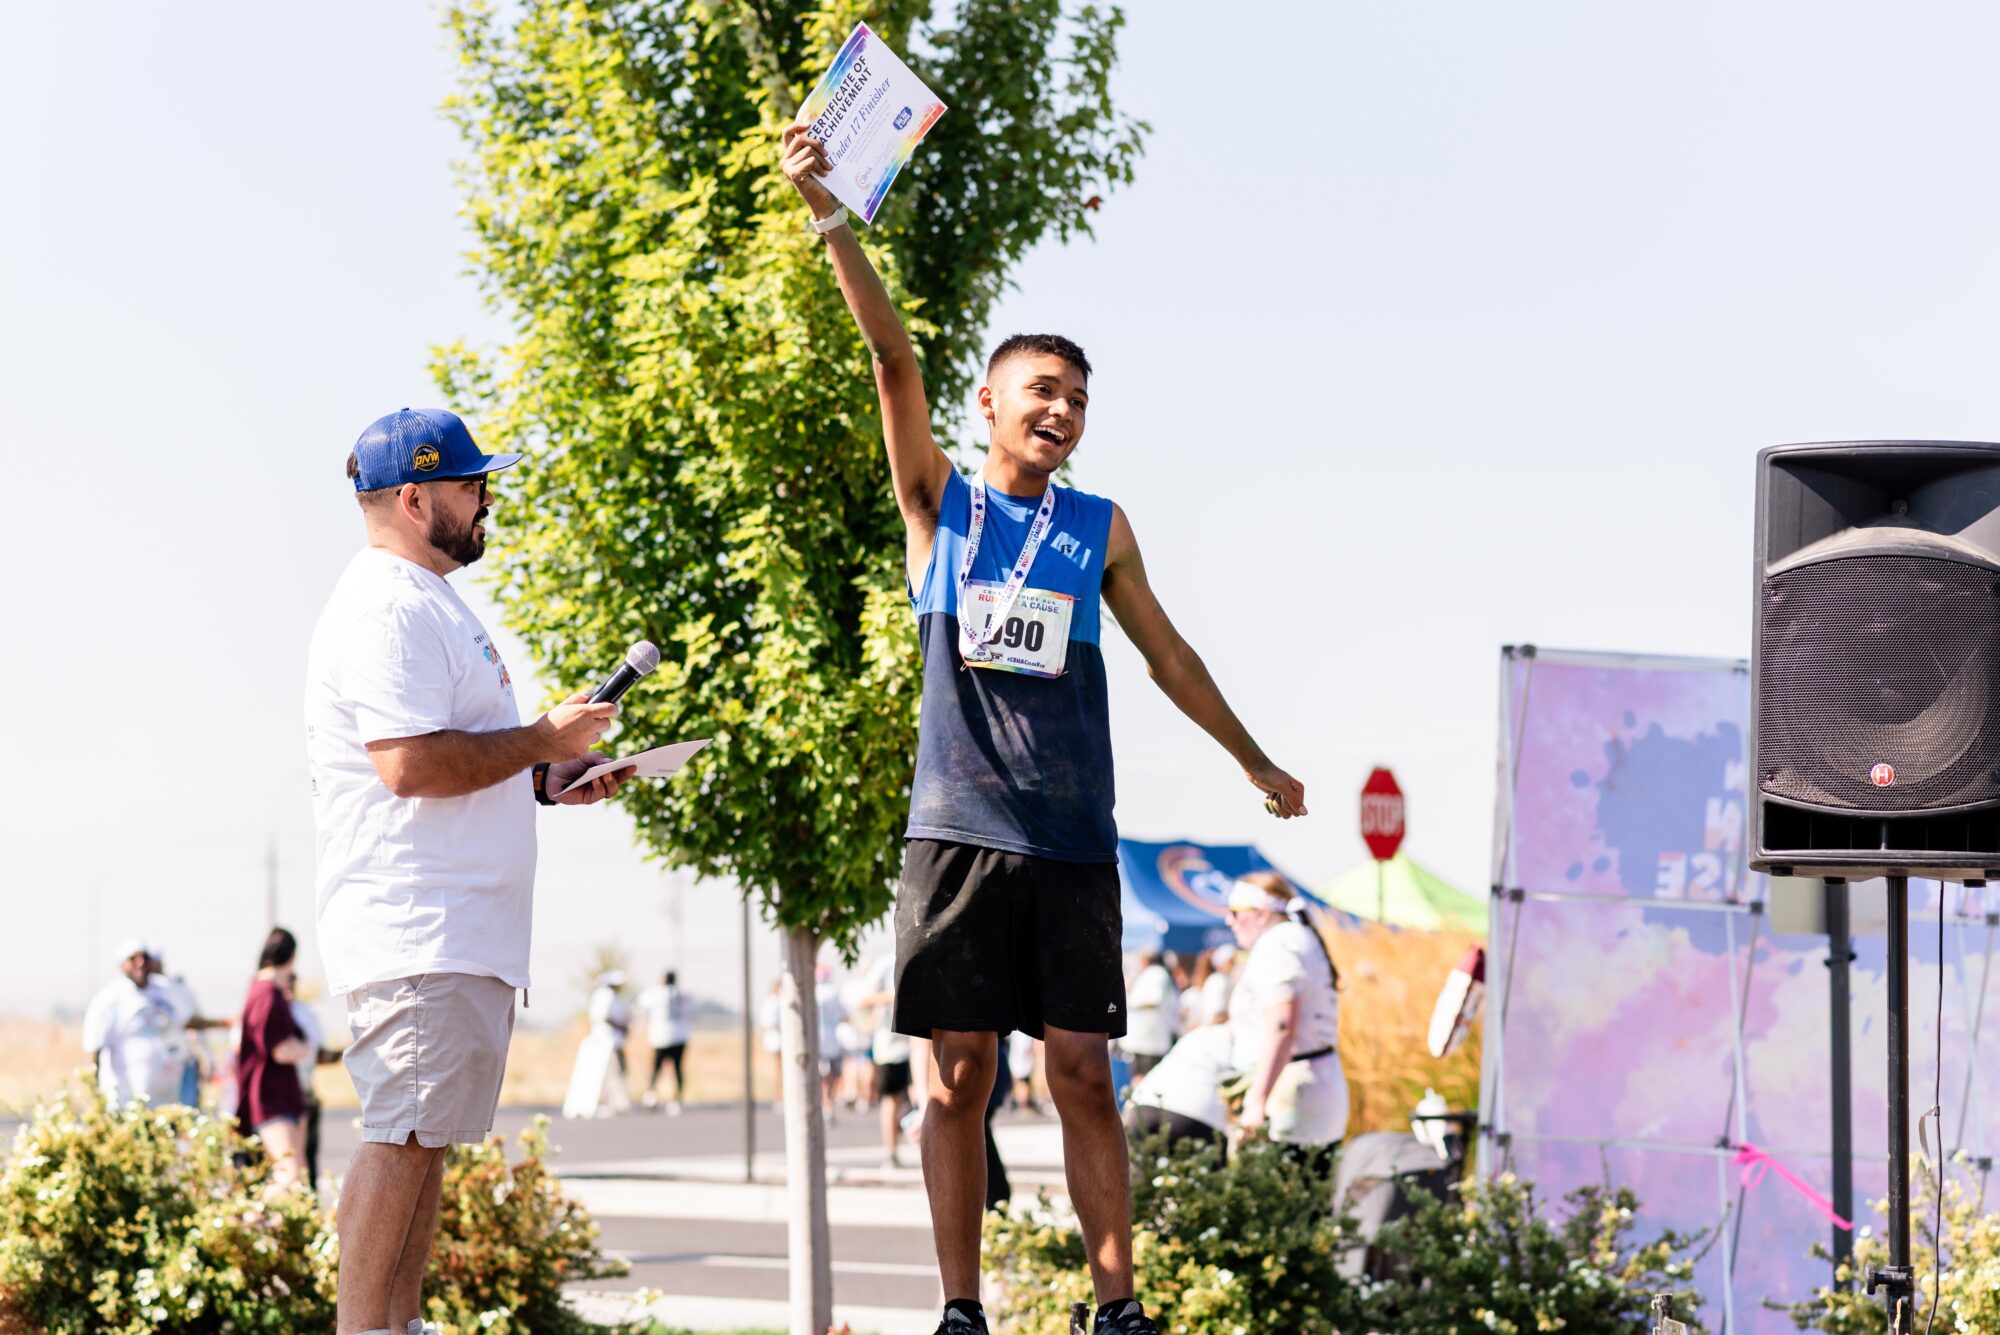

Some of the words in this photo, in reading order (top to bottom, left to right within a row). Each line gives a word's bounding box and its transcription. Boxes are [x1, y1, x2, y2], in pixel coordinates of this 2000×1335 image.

[807, 73, 856, 141] CERTIFICATE
[852, 55, 868, 74] OF
[822, 67, 873, 146] ACHIEVEMENT
[827, 132, 855, 167] Under
[848, 116, 863, 135] 17
[858, 77, 891, 121] Finisher
[414, 452, 439, 470] PNW
[1034, 521, 1044, 538] CAUSE
[978, 593, 999, 604] RUN
[1030, 602, 1060, 613] CAUSE
[1362, 794, 1404, 836] STOP
